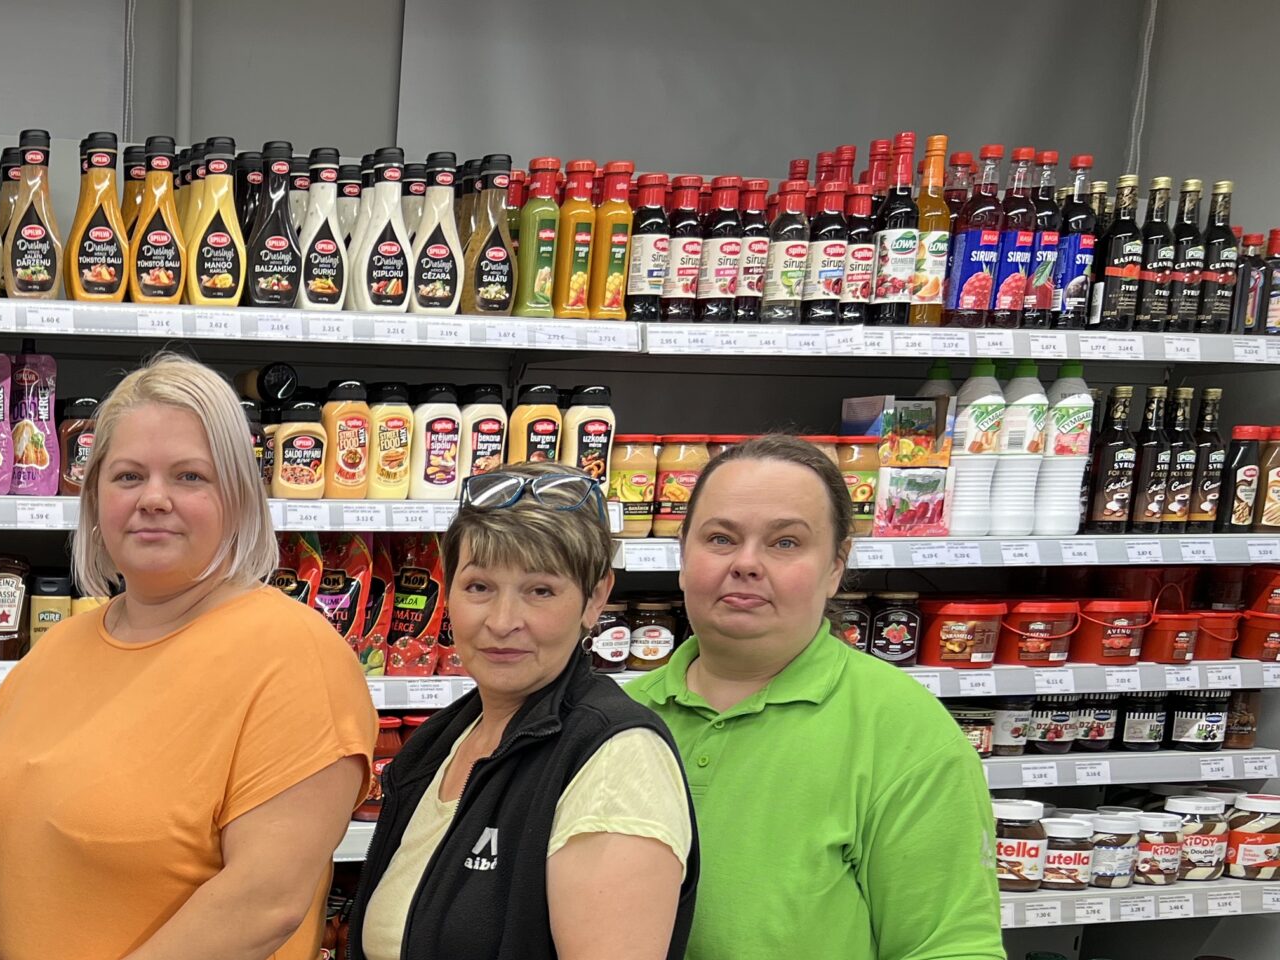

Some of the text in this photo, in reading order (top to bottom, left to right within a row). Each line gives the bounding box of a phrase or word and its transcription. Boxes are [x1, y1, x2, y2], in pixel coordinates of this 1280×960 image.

[204, 261, 233, 269] MANGO
[254, 265, 297, 273] BALZAMIKO
[339, 438, 359, 450] FOOD
[380, 438, 400, 449] FOOD
[996, 840, 1040, 858] tella
[1046, 853, 1090, 866] utella
